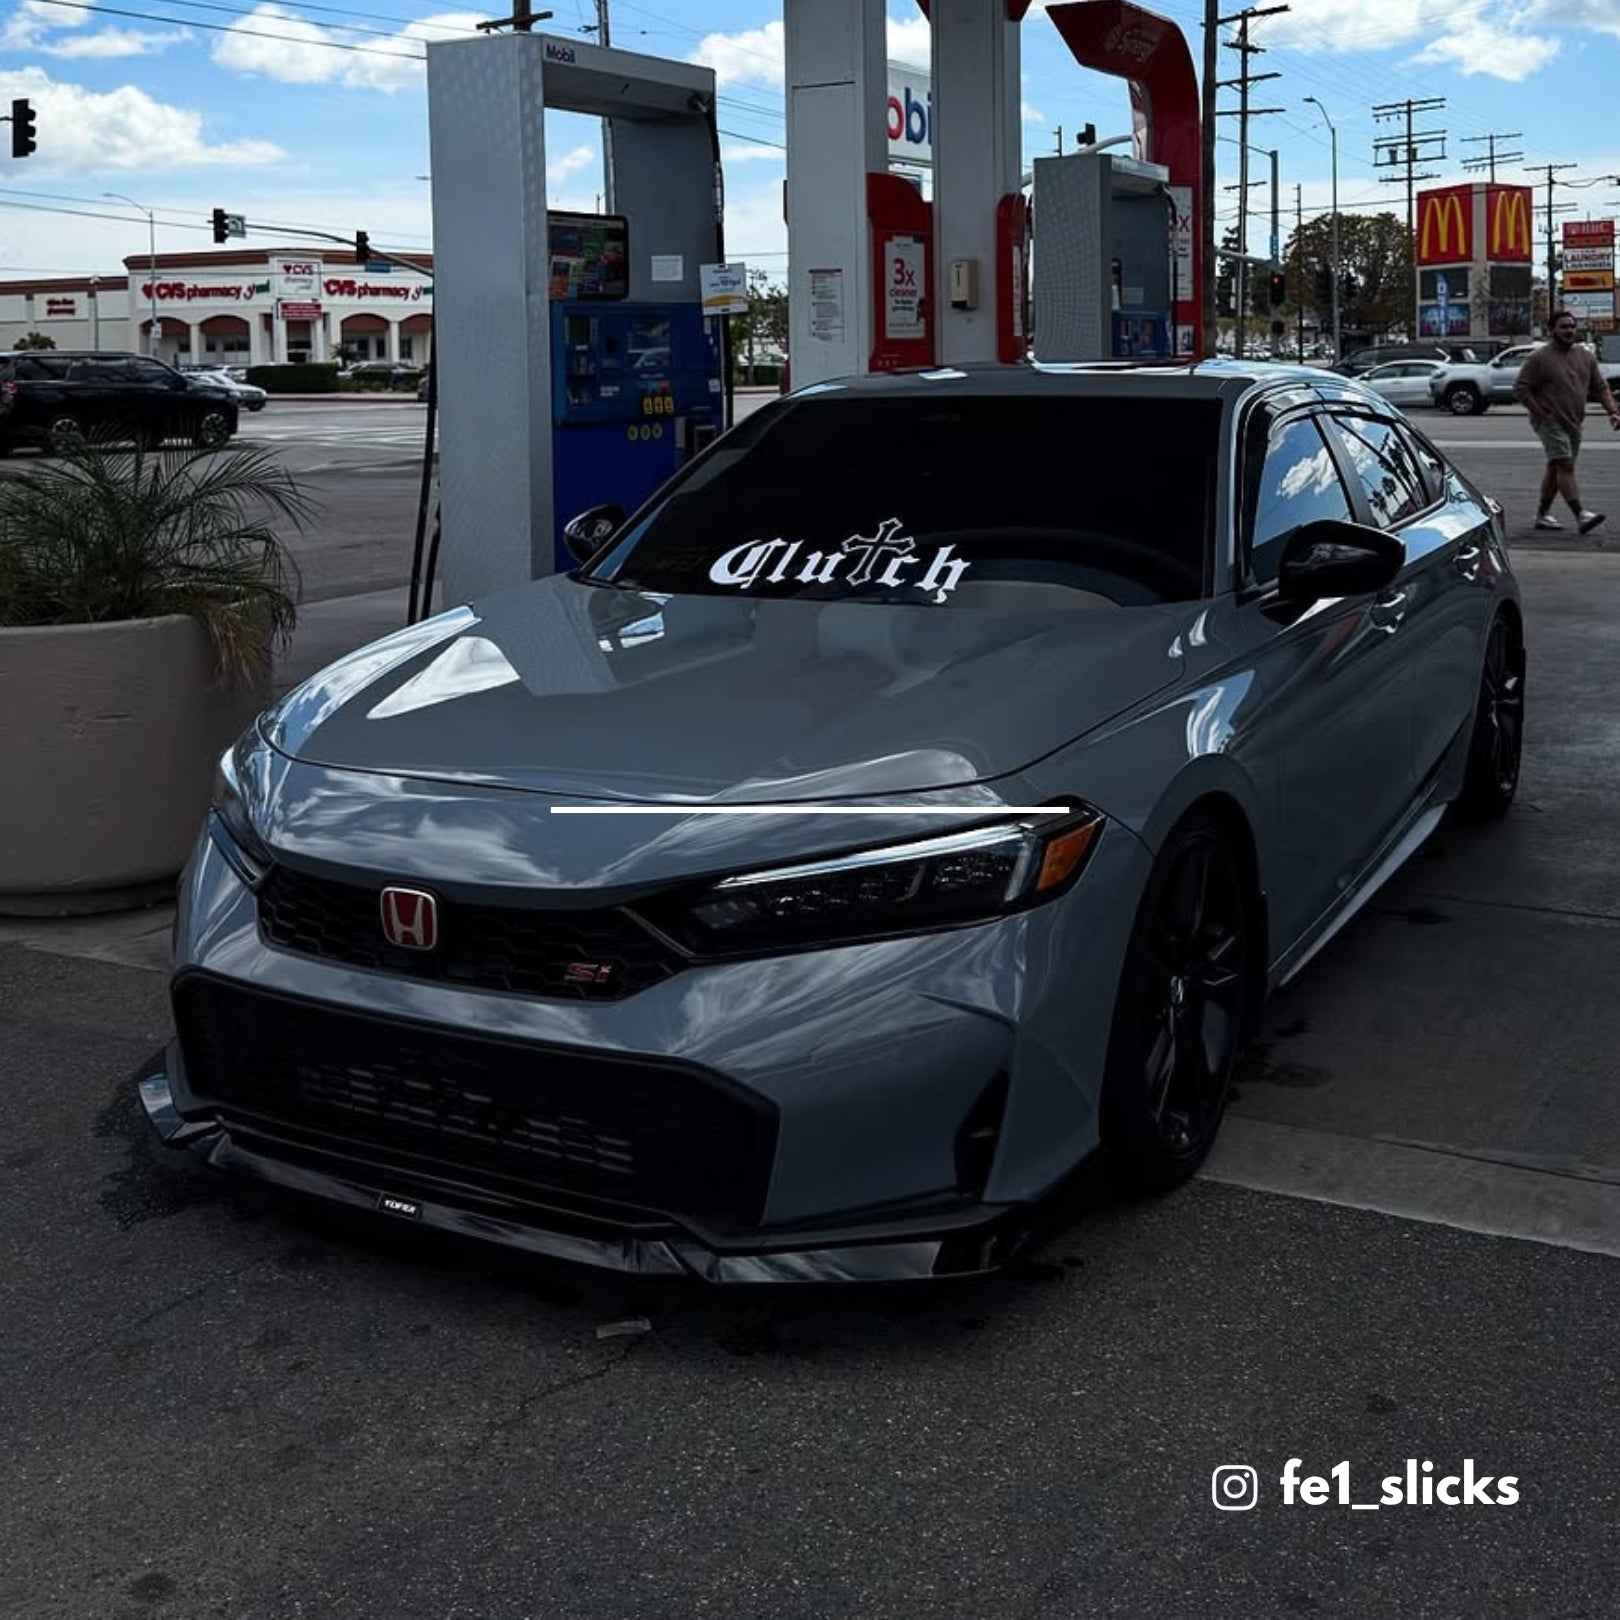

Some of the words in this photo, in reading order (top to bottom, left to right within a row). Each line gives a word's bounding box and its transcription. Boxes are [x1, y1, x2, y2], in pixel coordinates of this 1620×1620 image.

[546, 43, 576, 64] Mobil
[888, 87, 933, 146] obi
[293, 264, 314, 276] CVS
[156, 282, 186, 300] CVS
[187, 285, 242, 302] pharmacy
[325, 279, 357, 297] CVS
[358, 282, 412, 300] pharmacy
